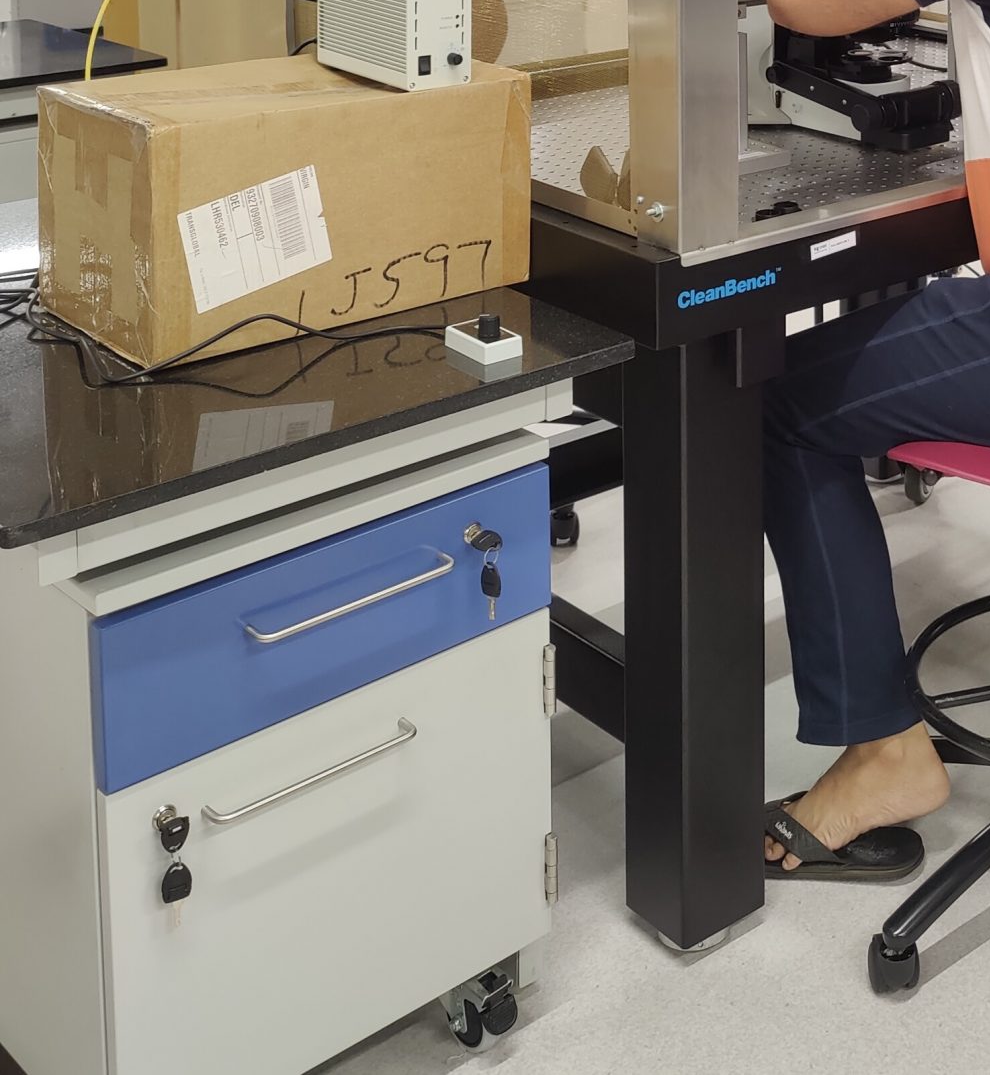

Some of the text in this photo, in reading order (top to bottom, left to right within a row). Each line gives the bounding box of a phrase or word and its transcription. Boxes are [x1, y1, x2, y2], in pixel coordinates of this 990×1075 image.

[210, 201, 229, 249] LHR530462
[230, 194, 241, 212] DEL
[185, 211, 200, 258] TRANSGLOBAL
